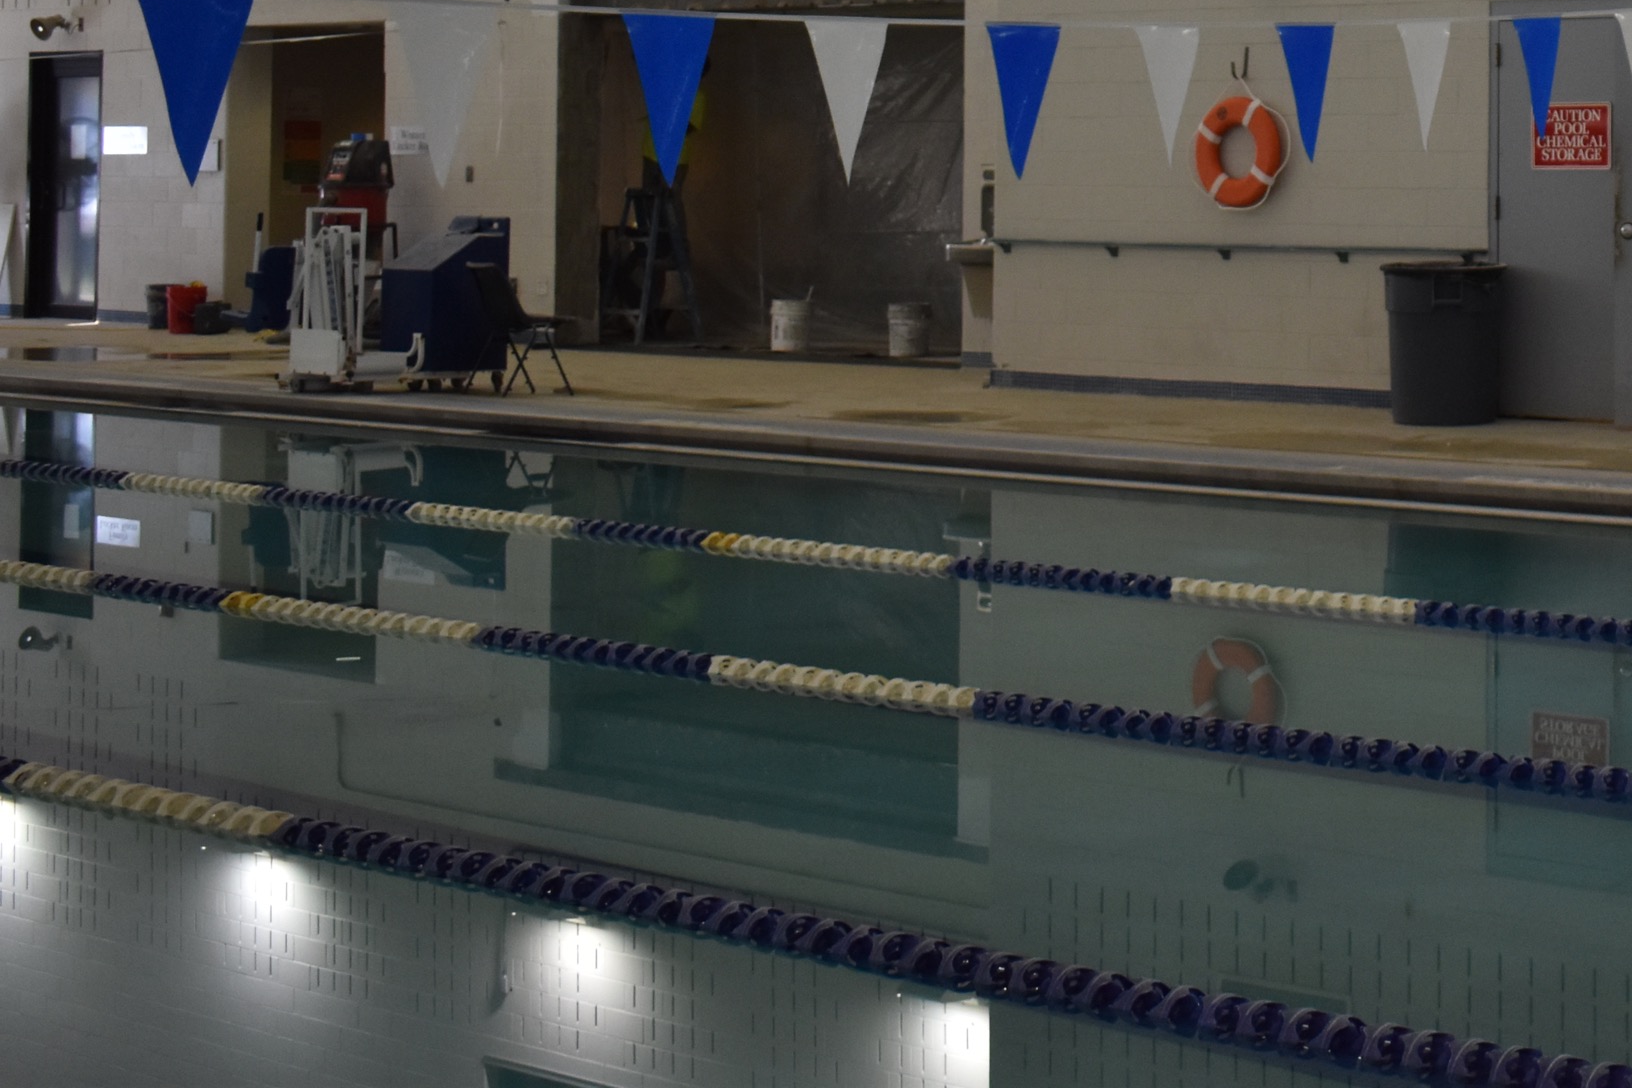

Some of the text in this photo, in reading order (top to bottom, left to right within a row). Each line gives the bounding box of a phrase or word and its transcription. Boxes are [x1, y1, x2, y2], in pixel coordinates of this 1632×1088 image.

[1554, 121, 1590, 135] POOL
[1536, 134, 1607, 148] CHEMICAL
[1541, 148, 1603, 161] STORAGE
